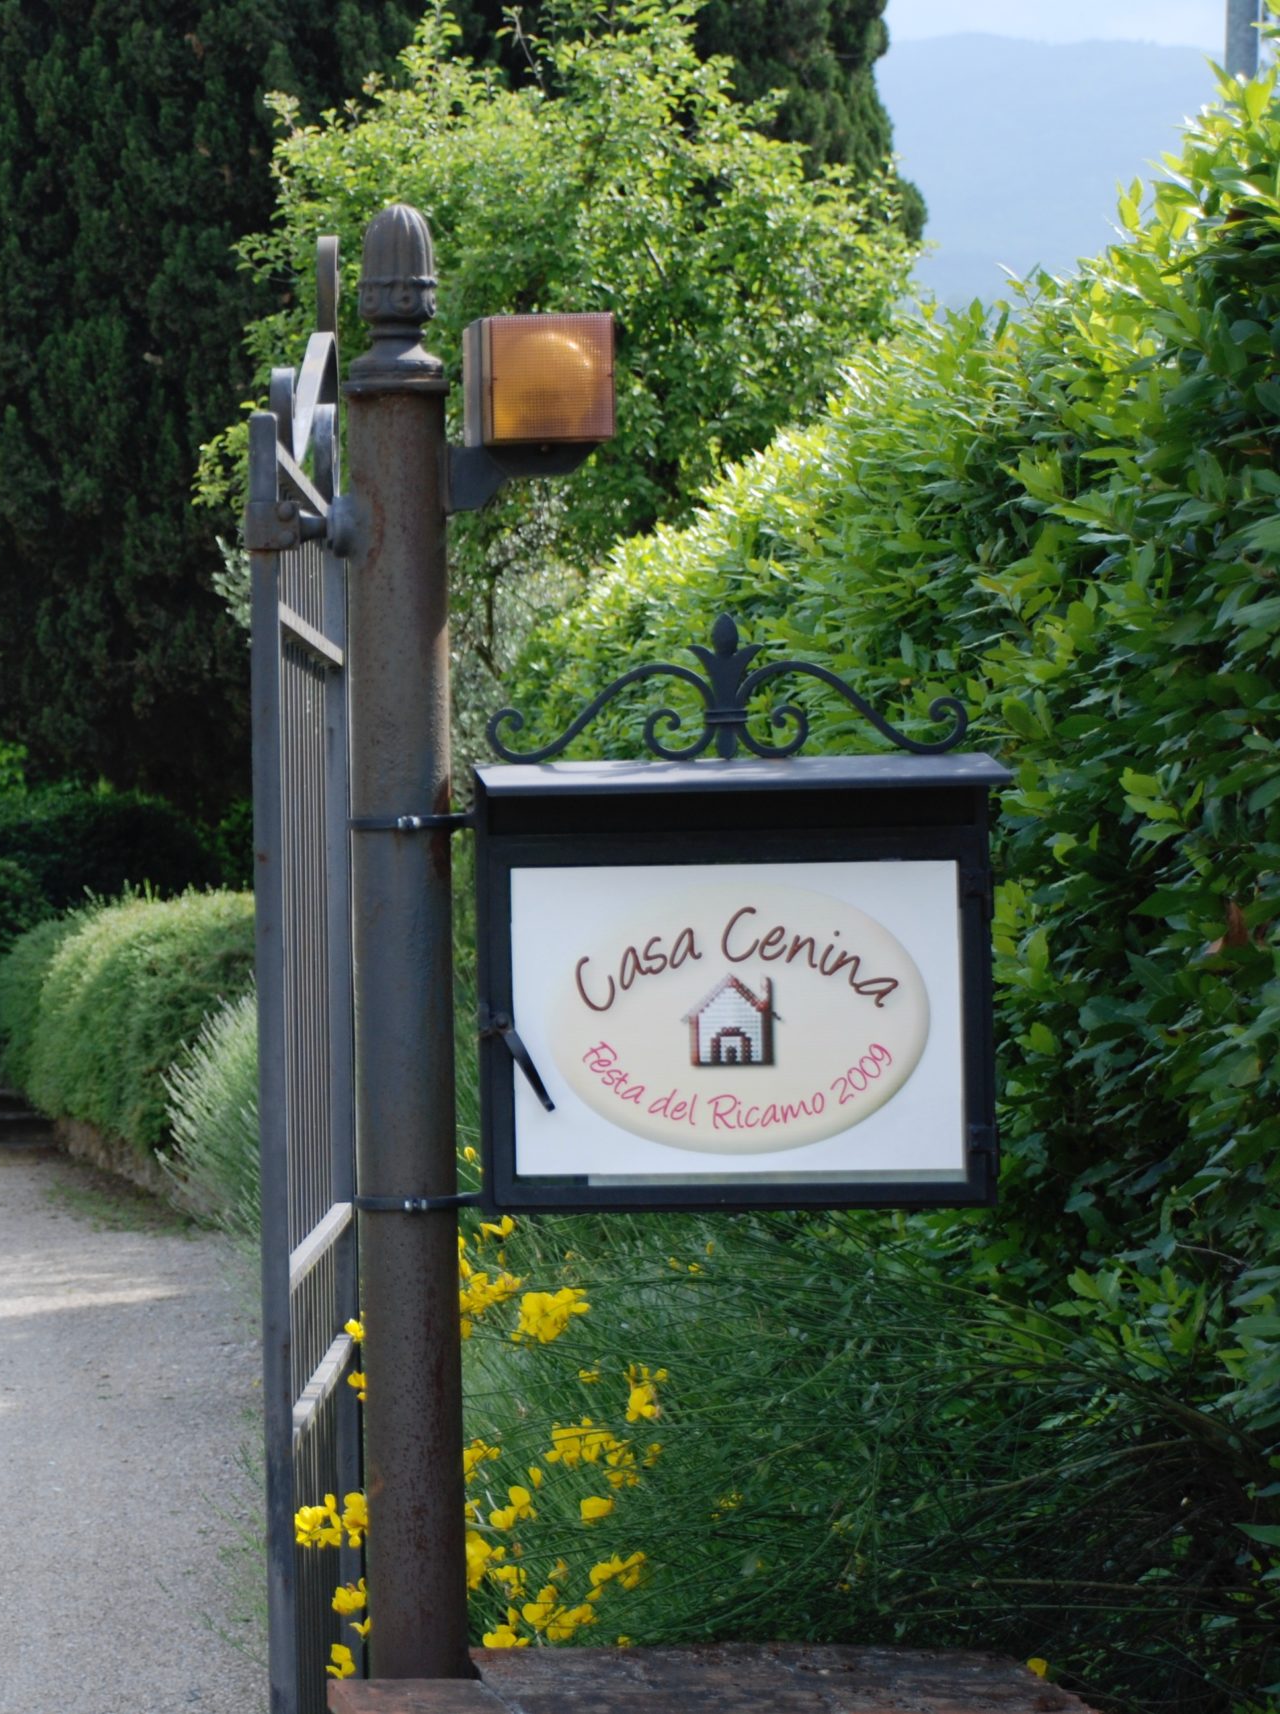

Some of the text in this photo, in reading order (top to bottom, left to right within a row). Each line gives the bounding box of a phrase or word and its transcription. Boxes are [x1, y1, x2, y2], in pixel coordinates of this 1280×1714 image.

[576, 906, 899, 1013] Casa Cenina
[582, 1041, 893, 1130] Festa del Ricamo 2009
